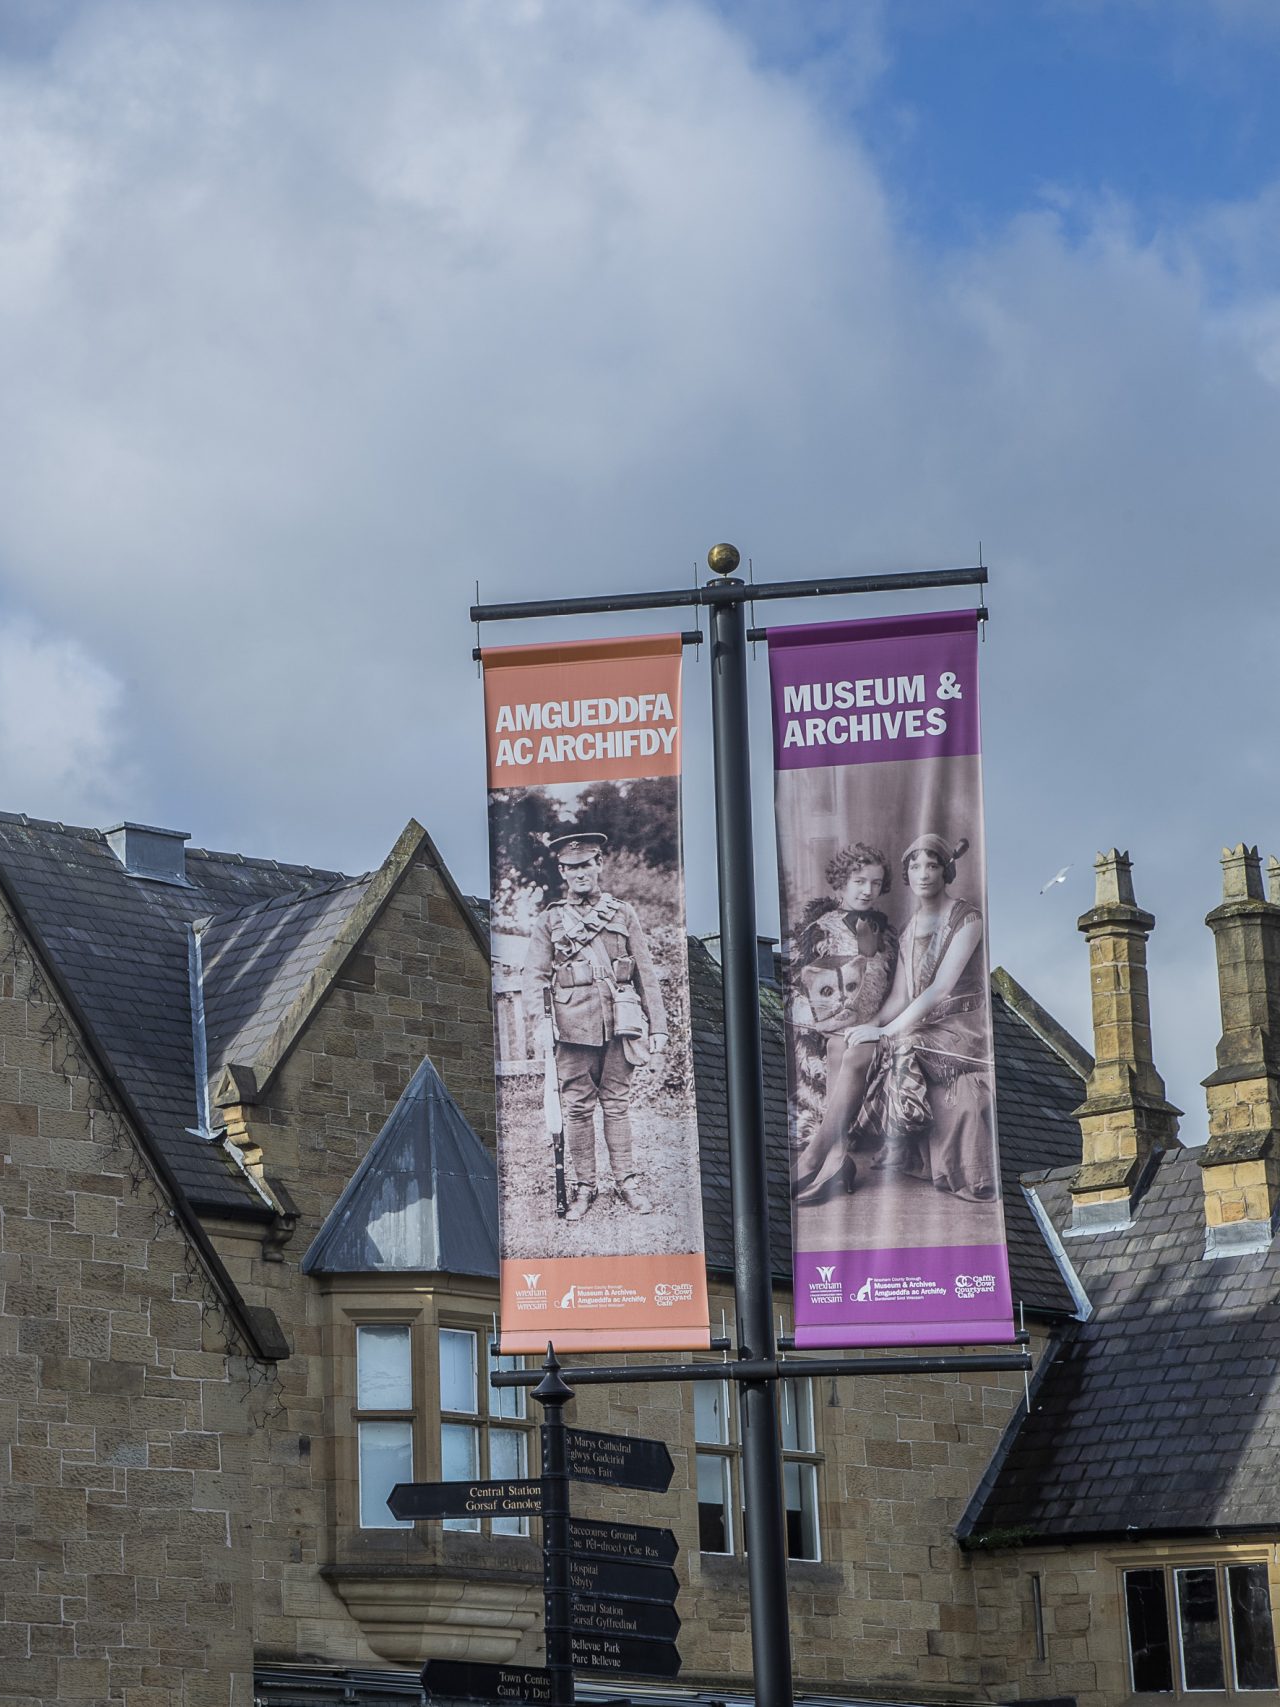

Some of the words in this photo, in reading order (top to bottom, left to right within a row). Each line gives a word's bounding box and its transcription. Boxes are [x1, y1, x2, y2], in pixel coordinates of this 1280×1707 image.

[783, 674, 926, 714] MUSEUM
[936, 671, 963, 700] &
[495, 692, 674, 733] AMGUEDDFA
[783, 707, 947, 748] ARCHIVES
[495, 737, 534, 767] AC
[536, 726, 678, 764] ARCHIFDY
[515, 1287, 547, 1297] wrexham
[808, 1280, 842, 1290] wrexham
[874, 1289, 910, 1297] Amgueddfa
[920, 1287, 947, 1296] Archifdy
[954, 1286, 995, 1294] Courtyard
[577, 1297, 612, 1305] Amgueddfa
[621, 1296, 646, 1304] Archifdy
[574, 1436, 596, 1451] Marys
[598, 1439, 631, 1454] Cathedral
[570, 1449, 591, 1463] glwys
[573, 1463, 596, 1475] Santes
[598, 1466, 613, 1478] Fair
[469, 1486, 505, 1498] Central
[508, 1485, 541, 1496] Station
[465, 1499, 498, 1511] Gorsaf
[502, 1498, 542, 1511] Ganolog
[568, 1524, 608, 1538] Racecourse
[609, 1529, 637, 1541] Ground
[628, 1544, 643, 1555] Cae
[644, 1546, 659, 1557] Ras
[569, 1562, 599, 1576] Hospital
[570, 1576, 593, 1590] Ysbyty
[599, 1604, 624, 1615] Station
[595, 1616, 637, 1630] Gyffredinol
[571, 1639, 601, 1651] Bellevue
[604, 1641, 621, 1653] Park
[571, 1653, 589, 1664] Parc
[591, 1655, 621, 1667] Bellevue
[499, 1671, 521, 1683] Town
[524, 1673, 551, 1685] Centre
[497, 1684, 520, 1697] Canol
